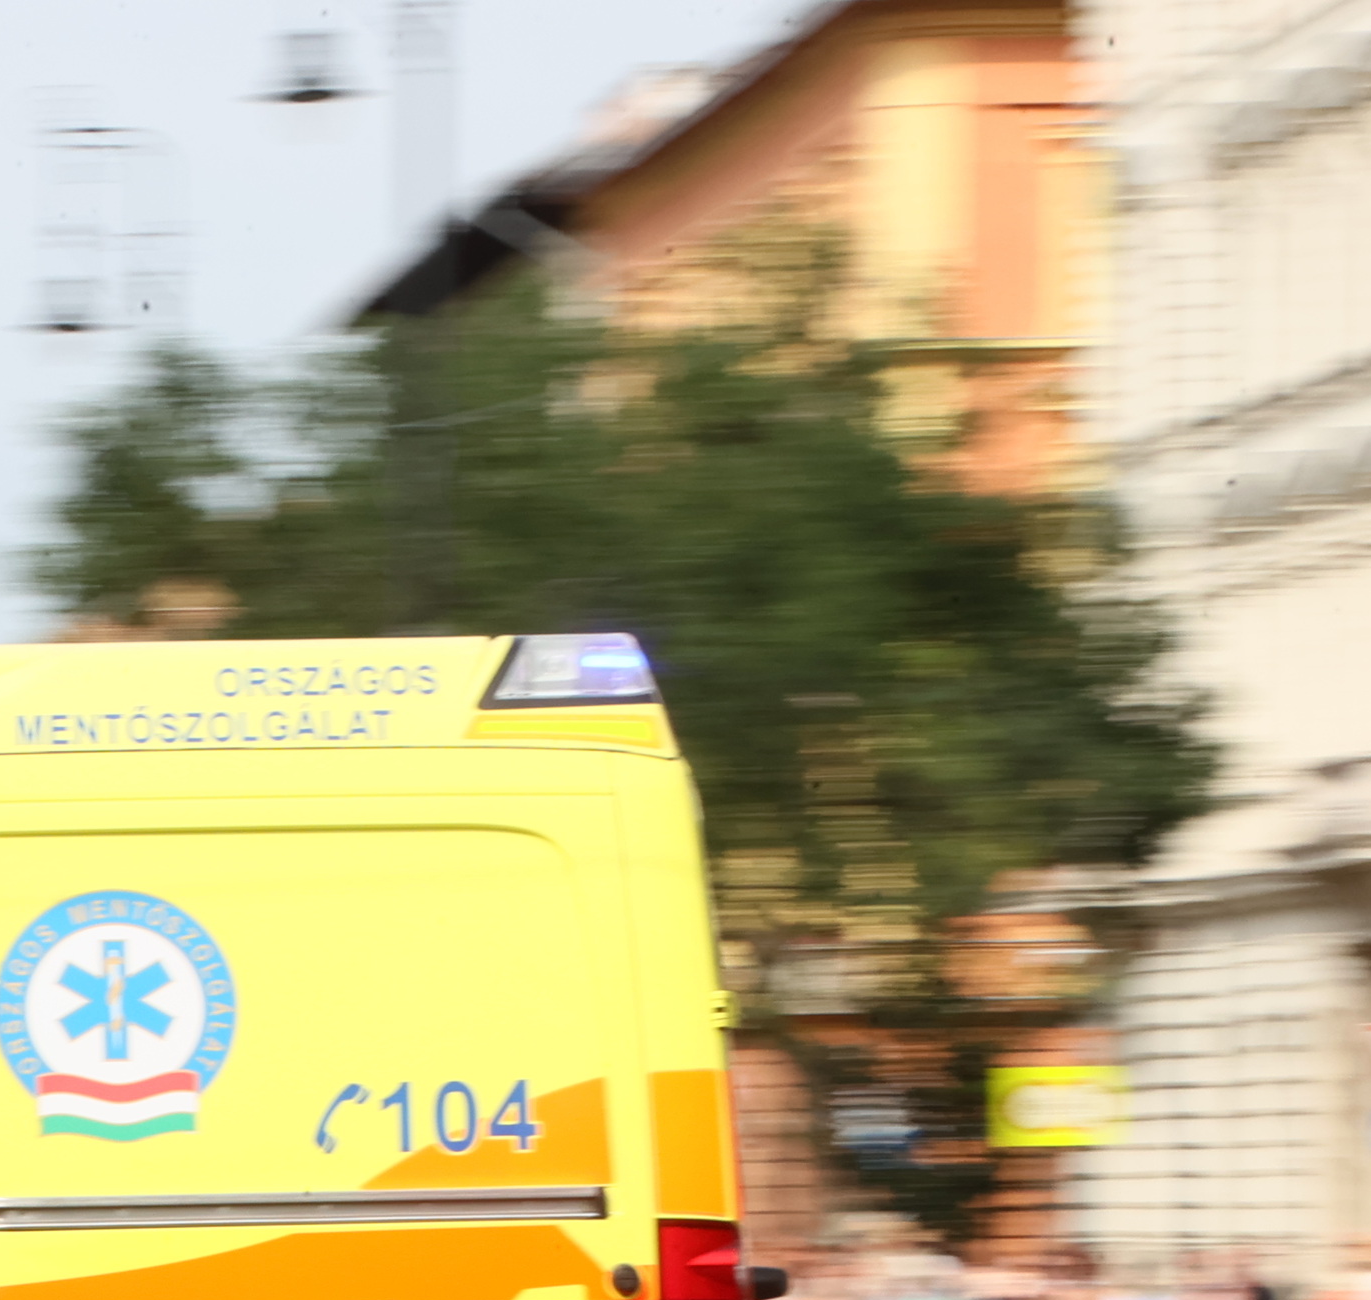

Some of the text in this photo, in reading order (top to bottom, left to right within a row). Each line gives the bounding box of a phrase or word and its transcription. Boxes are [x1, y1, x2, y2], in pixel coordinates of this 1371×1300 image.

[215, 660, 438, 697] ORSZÁGOS
[15, 705, 395, 745] MENTŐSZOLGÁLAT
[380, 1079, 540, 1152] 104
